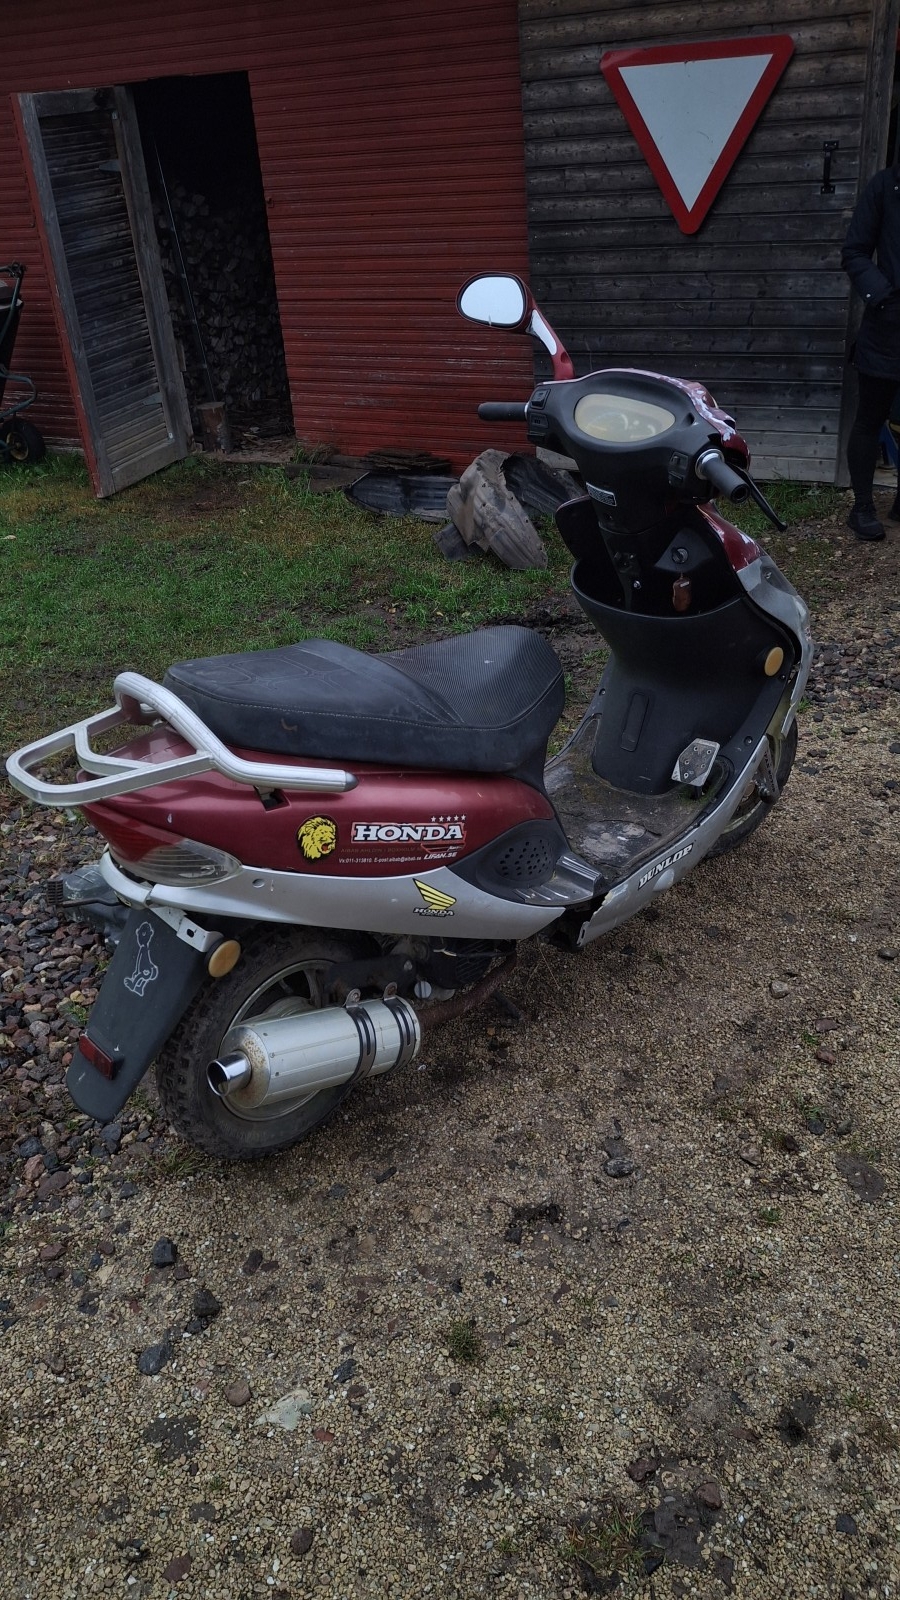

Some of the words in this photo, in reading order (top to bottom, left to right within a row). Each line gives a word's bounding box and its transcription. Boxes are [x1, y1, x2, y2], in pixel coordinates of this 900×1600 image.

[353, 825, 464, 841] HONDA
[424, 852, 458, 860] LIFAN.SE
[638, 843, 694, 889] DUNLOP
[413, 907, 455, 916] HONDA
